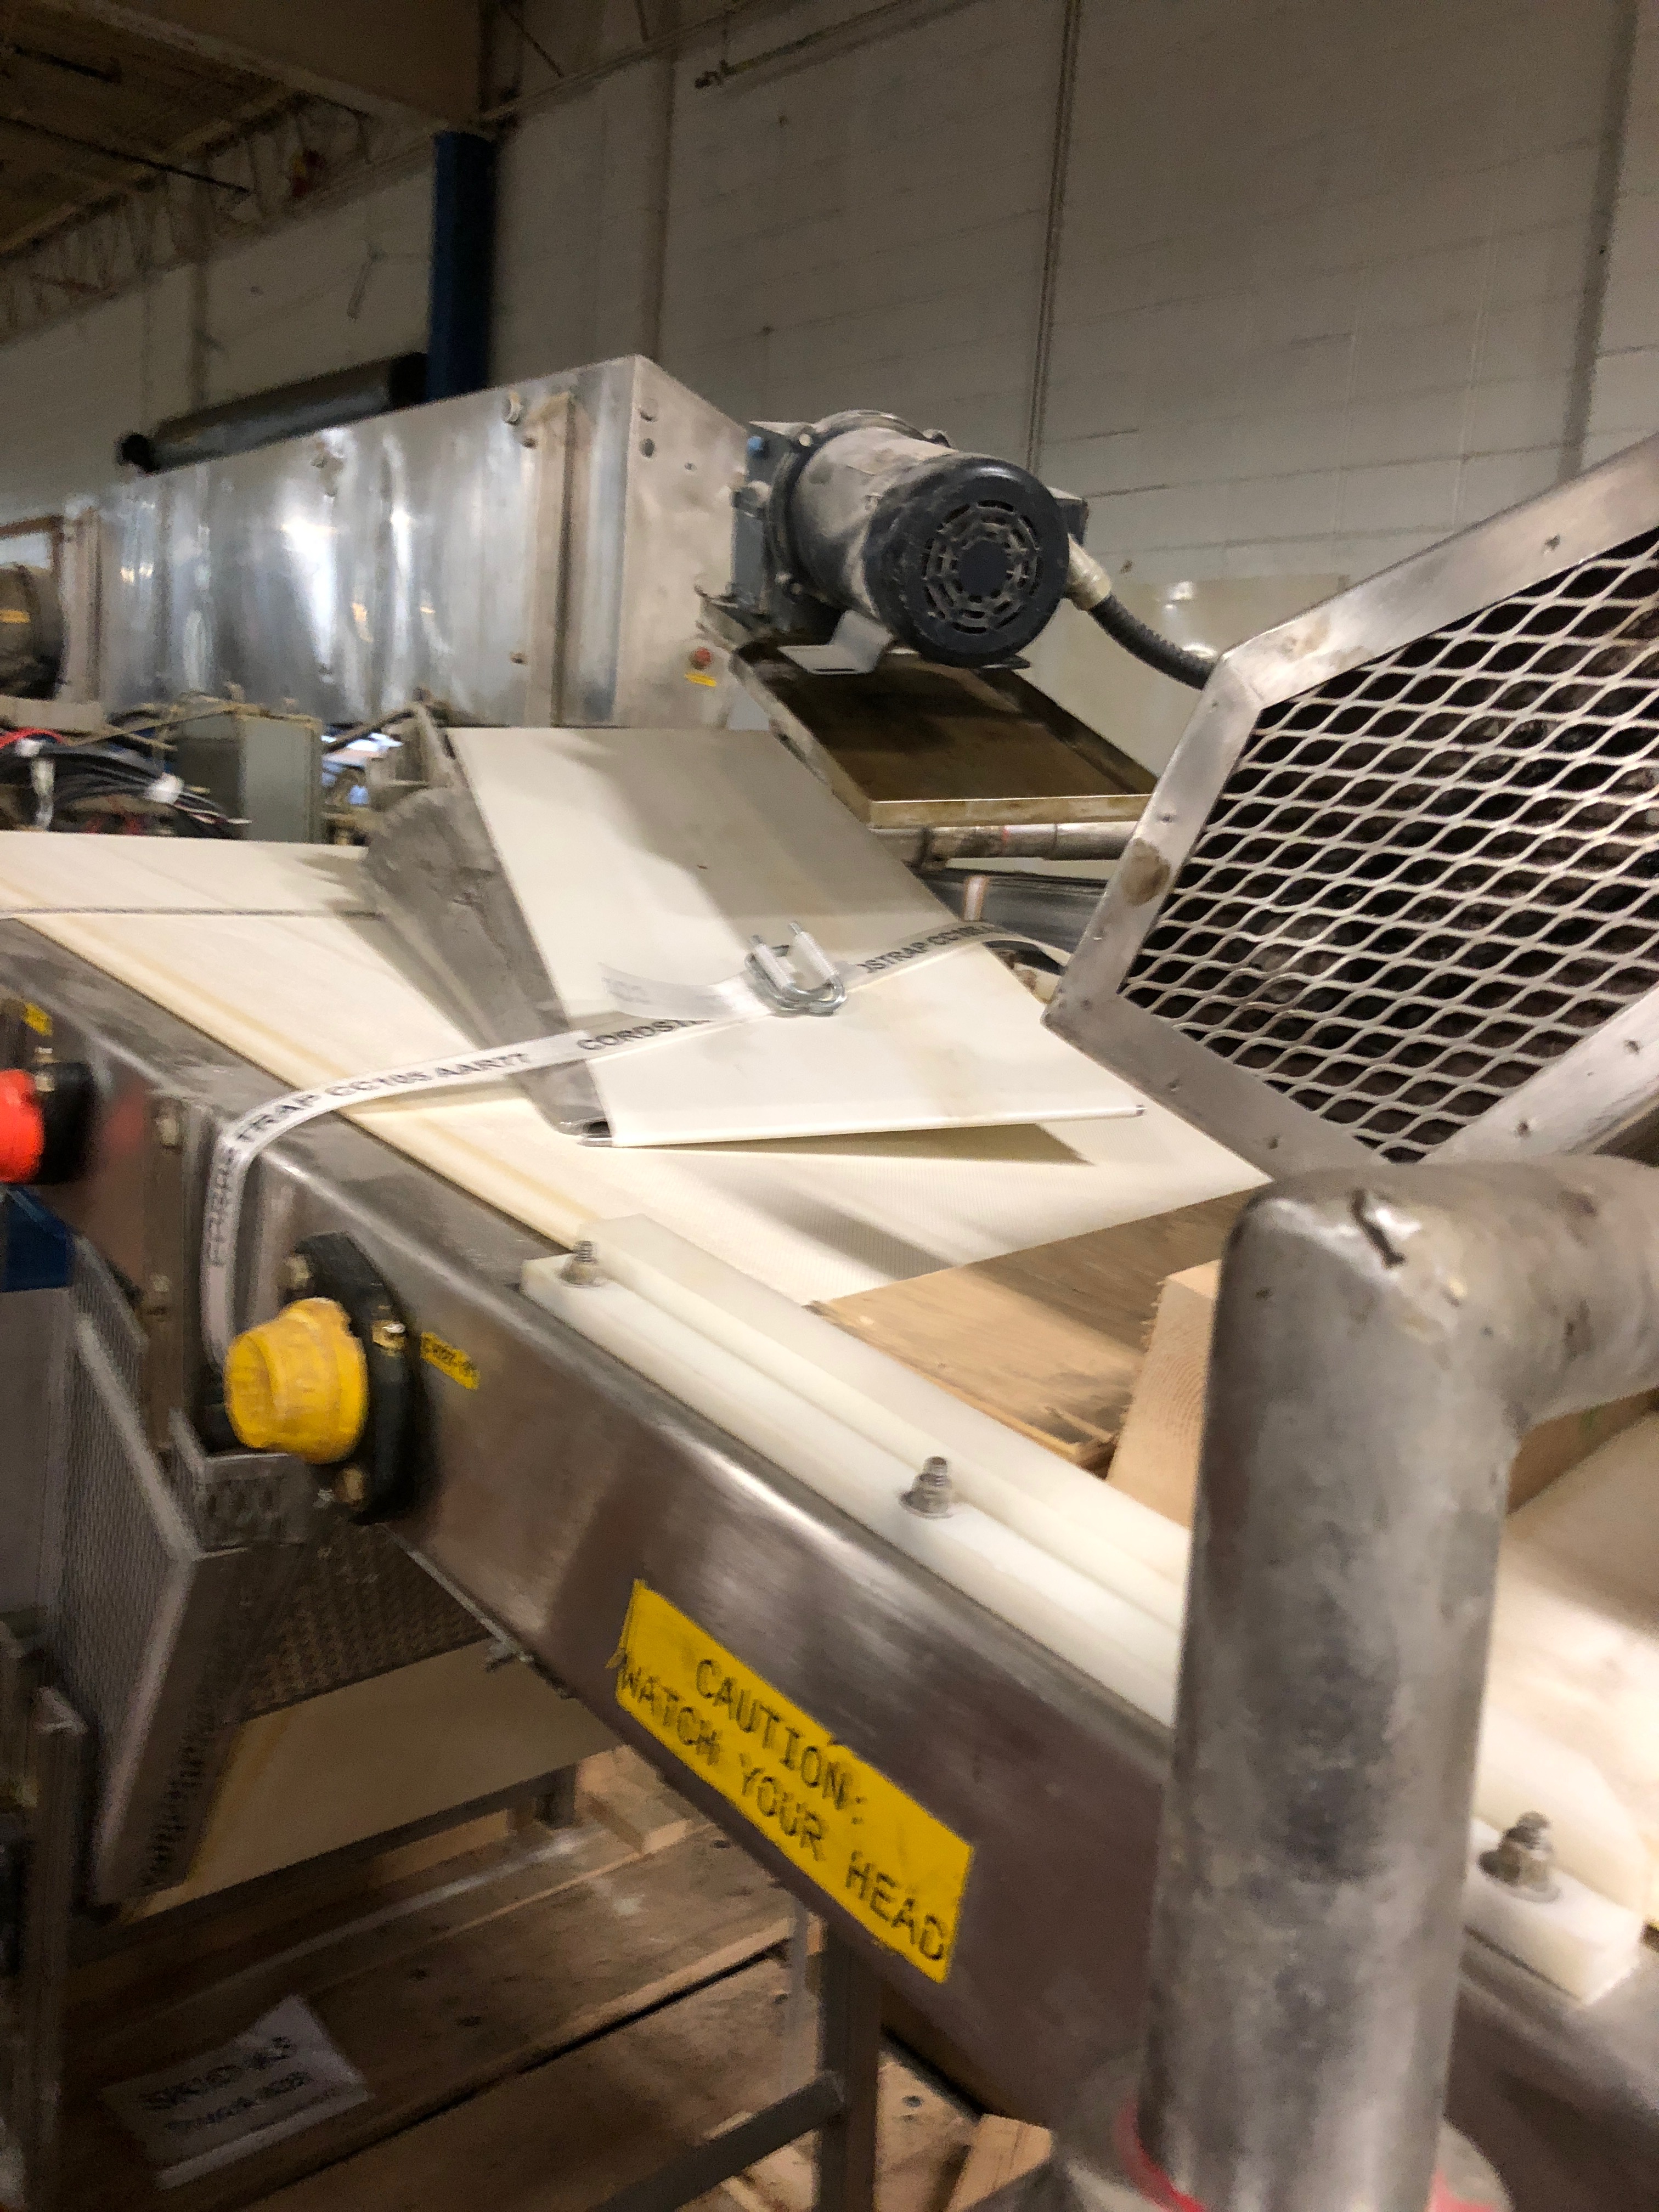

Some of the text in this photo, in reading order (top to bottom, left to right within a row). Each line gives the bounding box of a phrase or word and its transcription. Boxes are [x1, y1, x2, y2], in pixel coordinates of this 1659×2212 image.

[619, 1660, 946, 1962] WATCH YOUR HEAD
